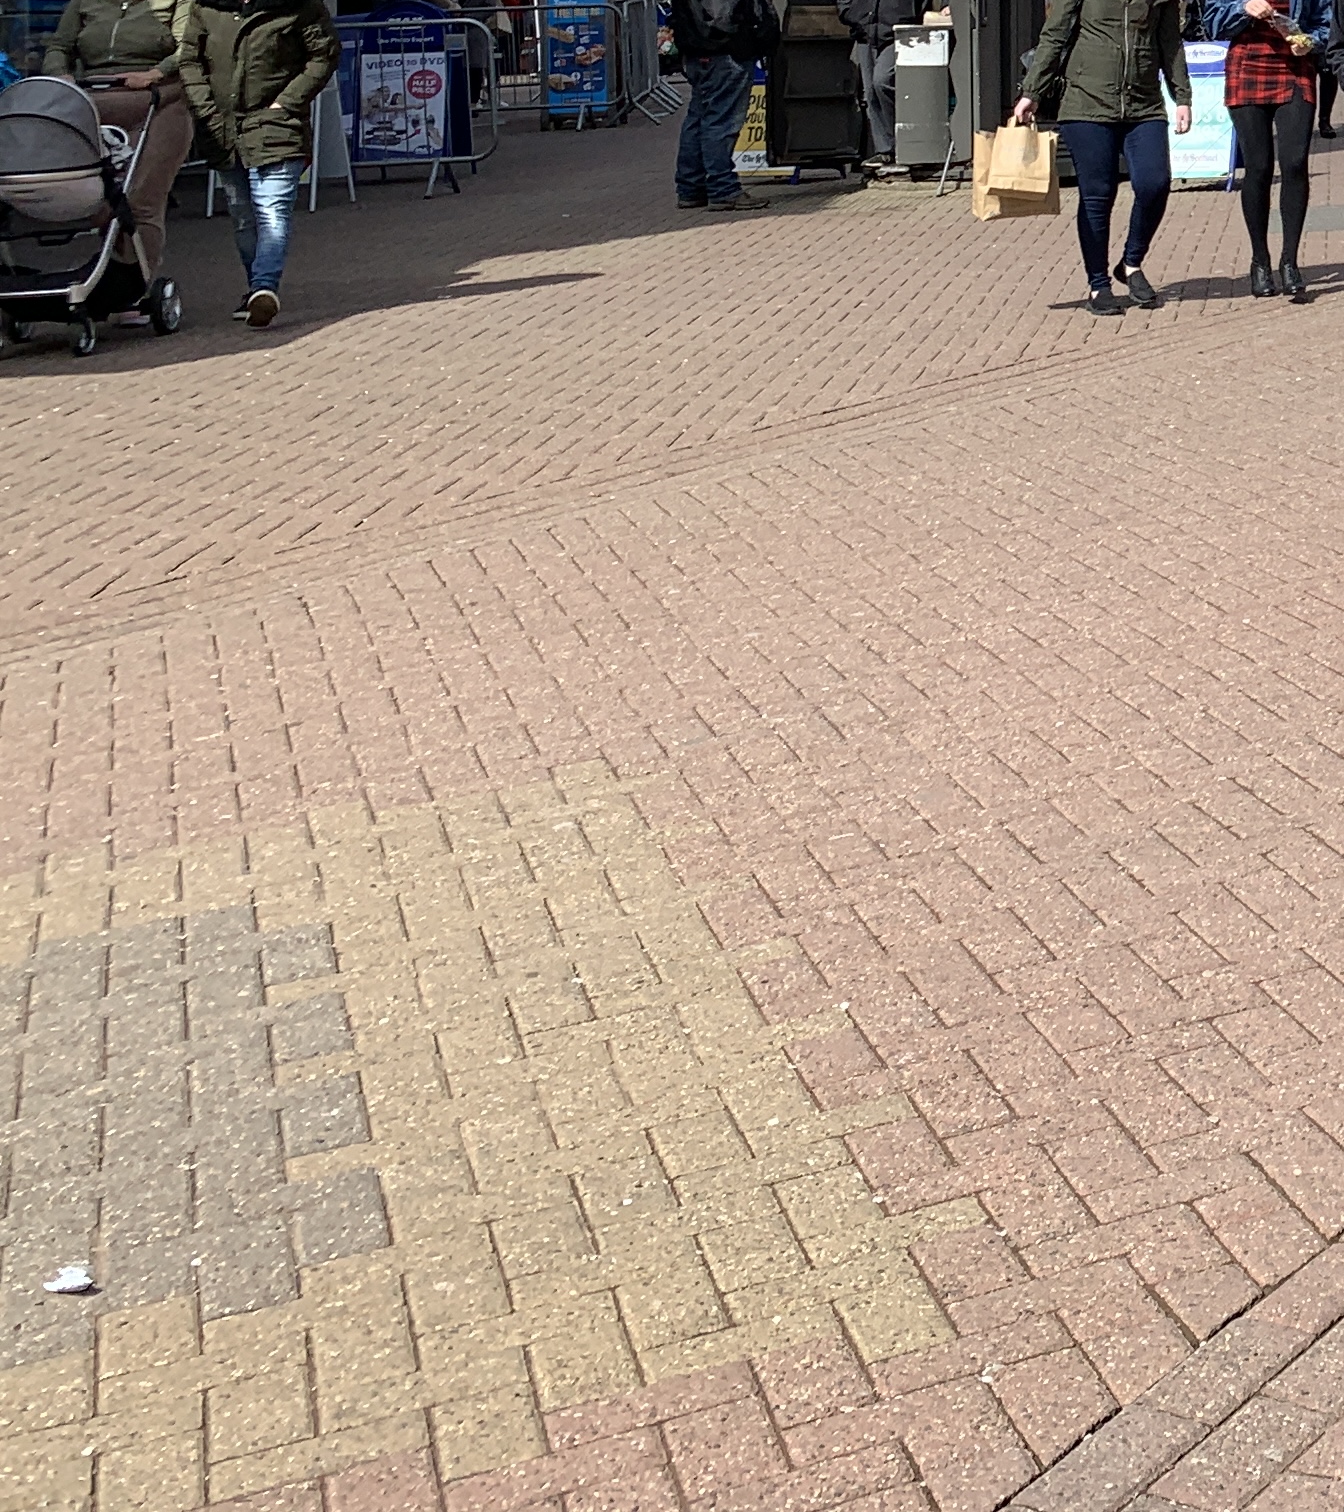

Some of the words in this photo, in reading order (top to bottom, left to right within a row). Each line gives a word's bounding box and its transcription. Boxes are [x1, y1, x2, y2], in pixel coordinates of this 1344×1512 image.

[365, 59, 403, 70] VIDEO
[419, 57, 445, 67] DVD
[412, 79, 437, 88] HALF
